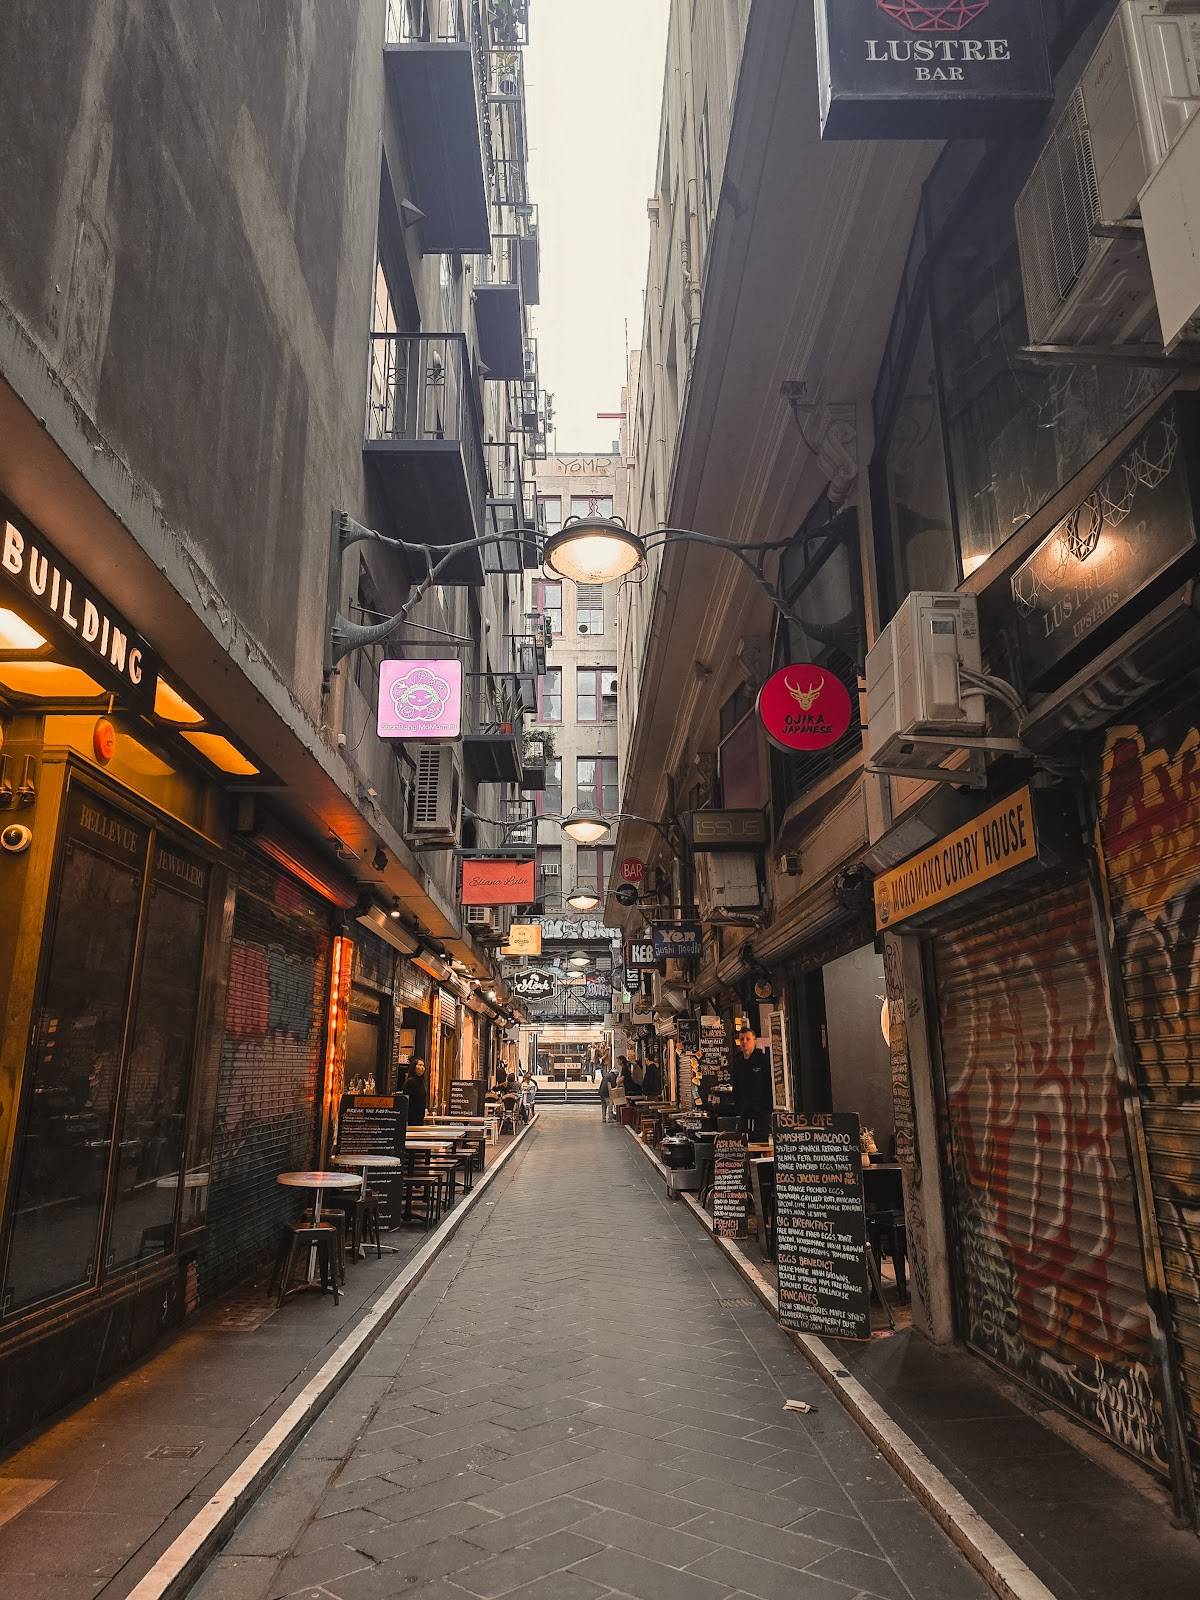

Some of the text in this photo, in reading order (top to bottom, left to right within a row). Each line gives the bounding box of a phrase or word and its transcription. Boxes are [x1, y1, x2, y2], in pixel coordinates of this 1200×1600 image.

[865, 40, 1010, 62] LUSTRE
[914, 67, 965, 81] BAR
[2, 521, 143, 685] BUILDING
[1073, 588, 1119, 638] UPSTAIRS
[785, 714, 826, 725] OJIKA
[782, 725, 833, 734] JAPANESE
[80, 804, 138, 854] BELLEVUE
[891, 803, 1027, 913] MOKOMOKO CURRY HOUSE
[157, 850, 206, 889] JEWELLERY
[624, 864, 643, 878] BAR
[632, 944, 656, 963] KEB
[776, 1114, 833, 1128] ISSUS CAFE
[777, 1132, 851, 1144] SMASHED AVOCADO
[776, 1173, 795, 1184] EGGS
[822, 1174, 842, 1184] CHAN
[714, 1219, 739, 1231] FRENCH
[777, 1216, 835, 1234] BIG BREAKFAST
[720, 1229, 737, 1239] TOAST
[778, 1254, 835, 1272] EGGS BENEDICT
[781, 1289, 819, 1306] PANCAKES
